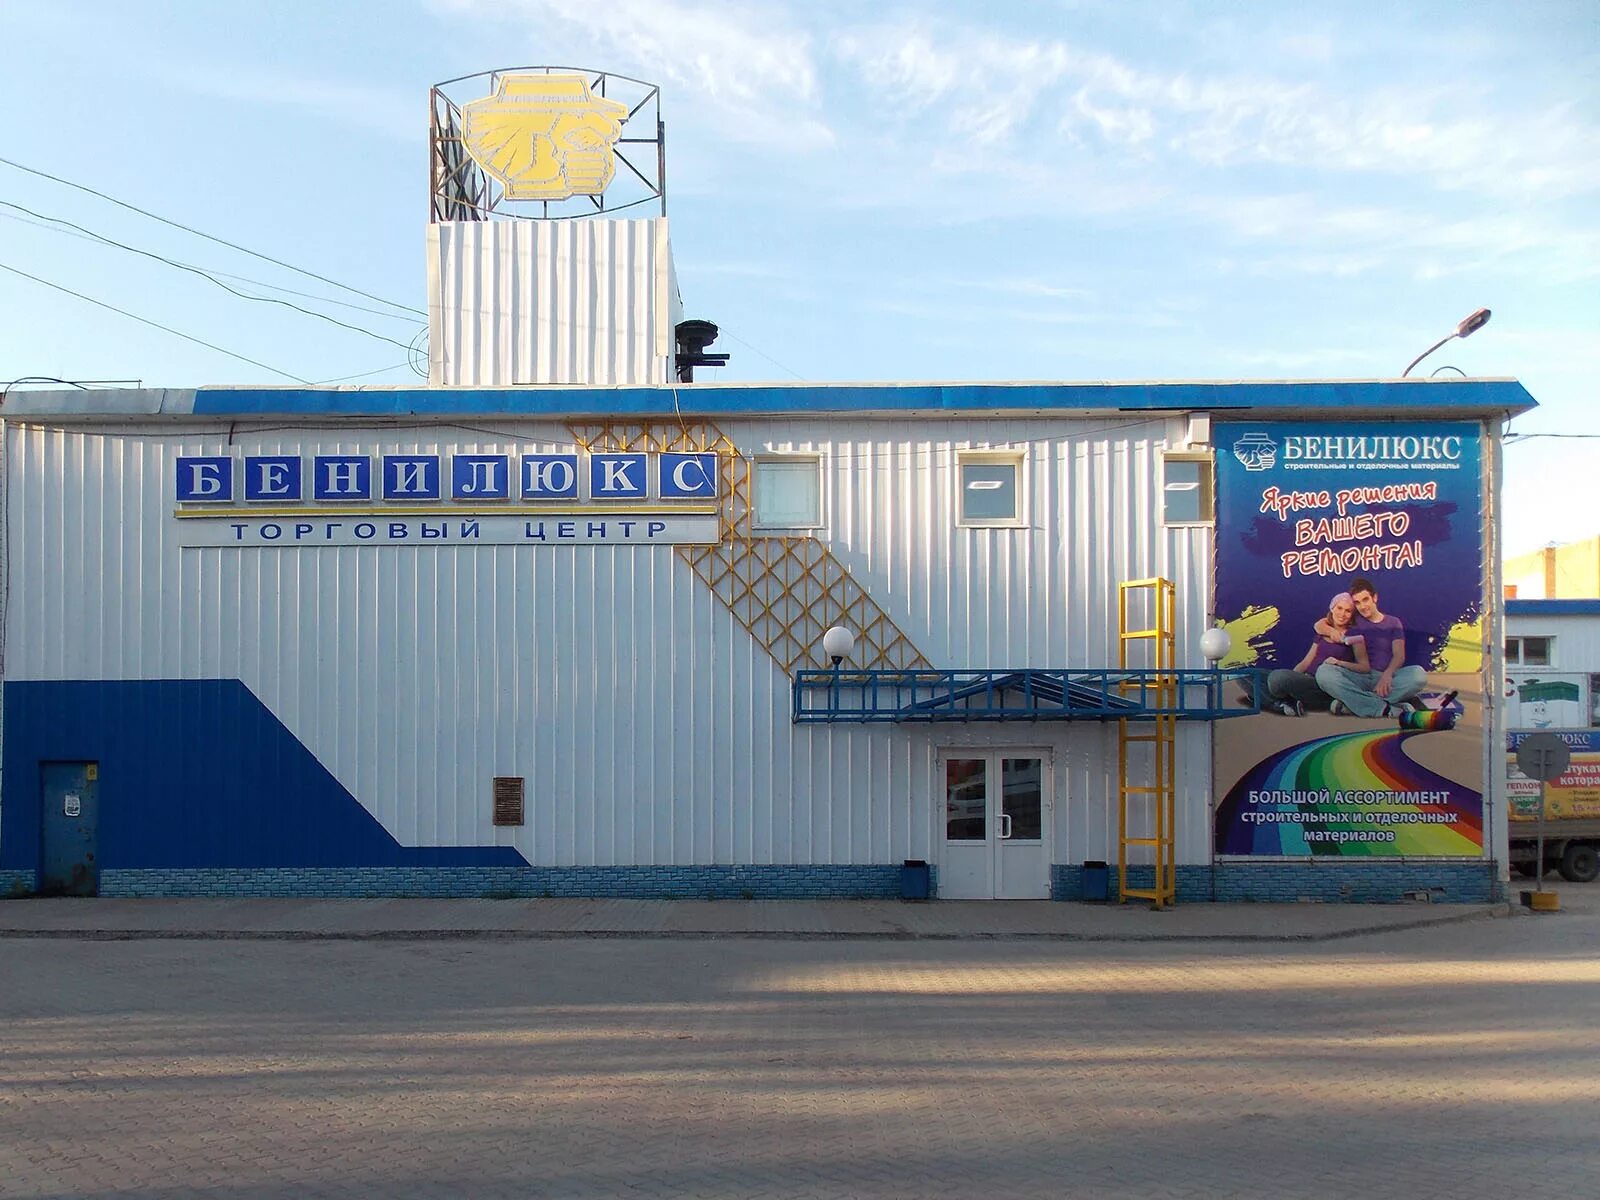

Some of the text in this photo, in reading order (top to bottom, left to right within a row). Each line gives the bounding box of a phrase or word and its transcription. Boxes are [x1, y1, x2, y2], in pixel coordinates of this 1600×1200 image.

[1283, 436, 1461, 460] БЕНИЛЮКС
[189, 459, 704, 495] БЕНИЛЮКС
[1260, 482, 1436, 520] Яркие решения
[231, 519, 667, 541] ТОРГОВЫЙ ЦЕНТР
[1296, 512, 1409, 546] ВАШЕГО
[1281, 541, 1423, 578] РЕМОНТА!
[1249, 788, 1450, 804] БОЛЬШОЙ АССОРТИМЕНТ
[1241, 812, 1458, 824] строительных и отделочных
[1303, 831, 1395, 843] материалов
